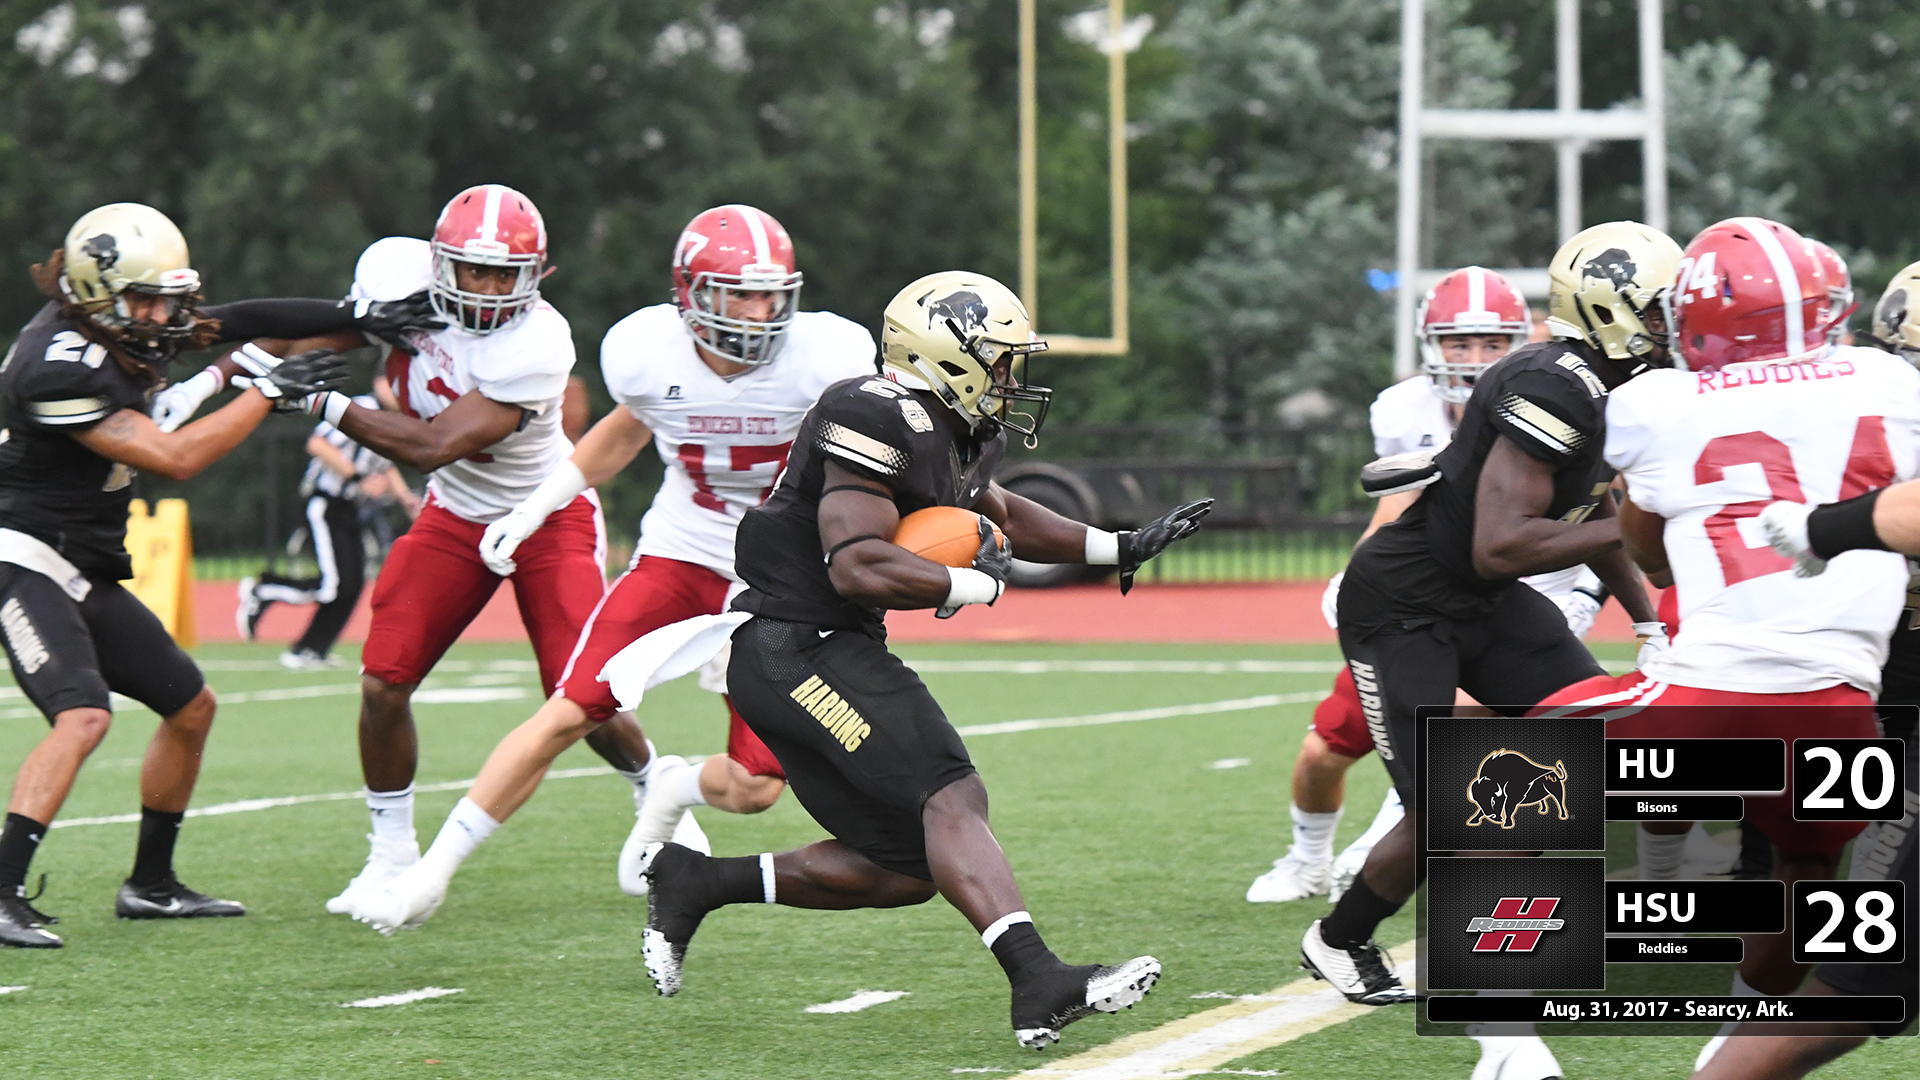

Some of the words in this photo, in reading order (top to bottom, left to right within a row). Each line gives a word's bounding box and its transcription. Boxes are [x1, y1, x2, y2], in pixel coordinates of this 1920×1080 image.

[673, 231, 710, 267] 17
[1675, 252, 1718, 304] 24
[45, 330, 108, 368] 21
[859, 377, 934, 433] 28
[677, 440, 796, 515] 17
[789, 673, 872, 753] HARDING
[1348, 659, 1395, 761] HARDING
